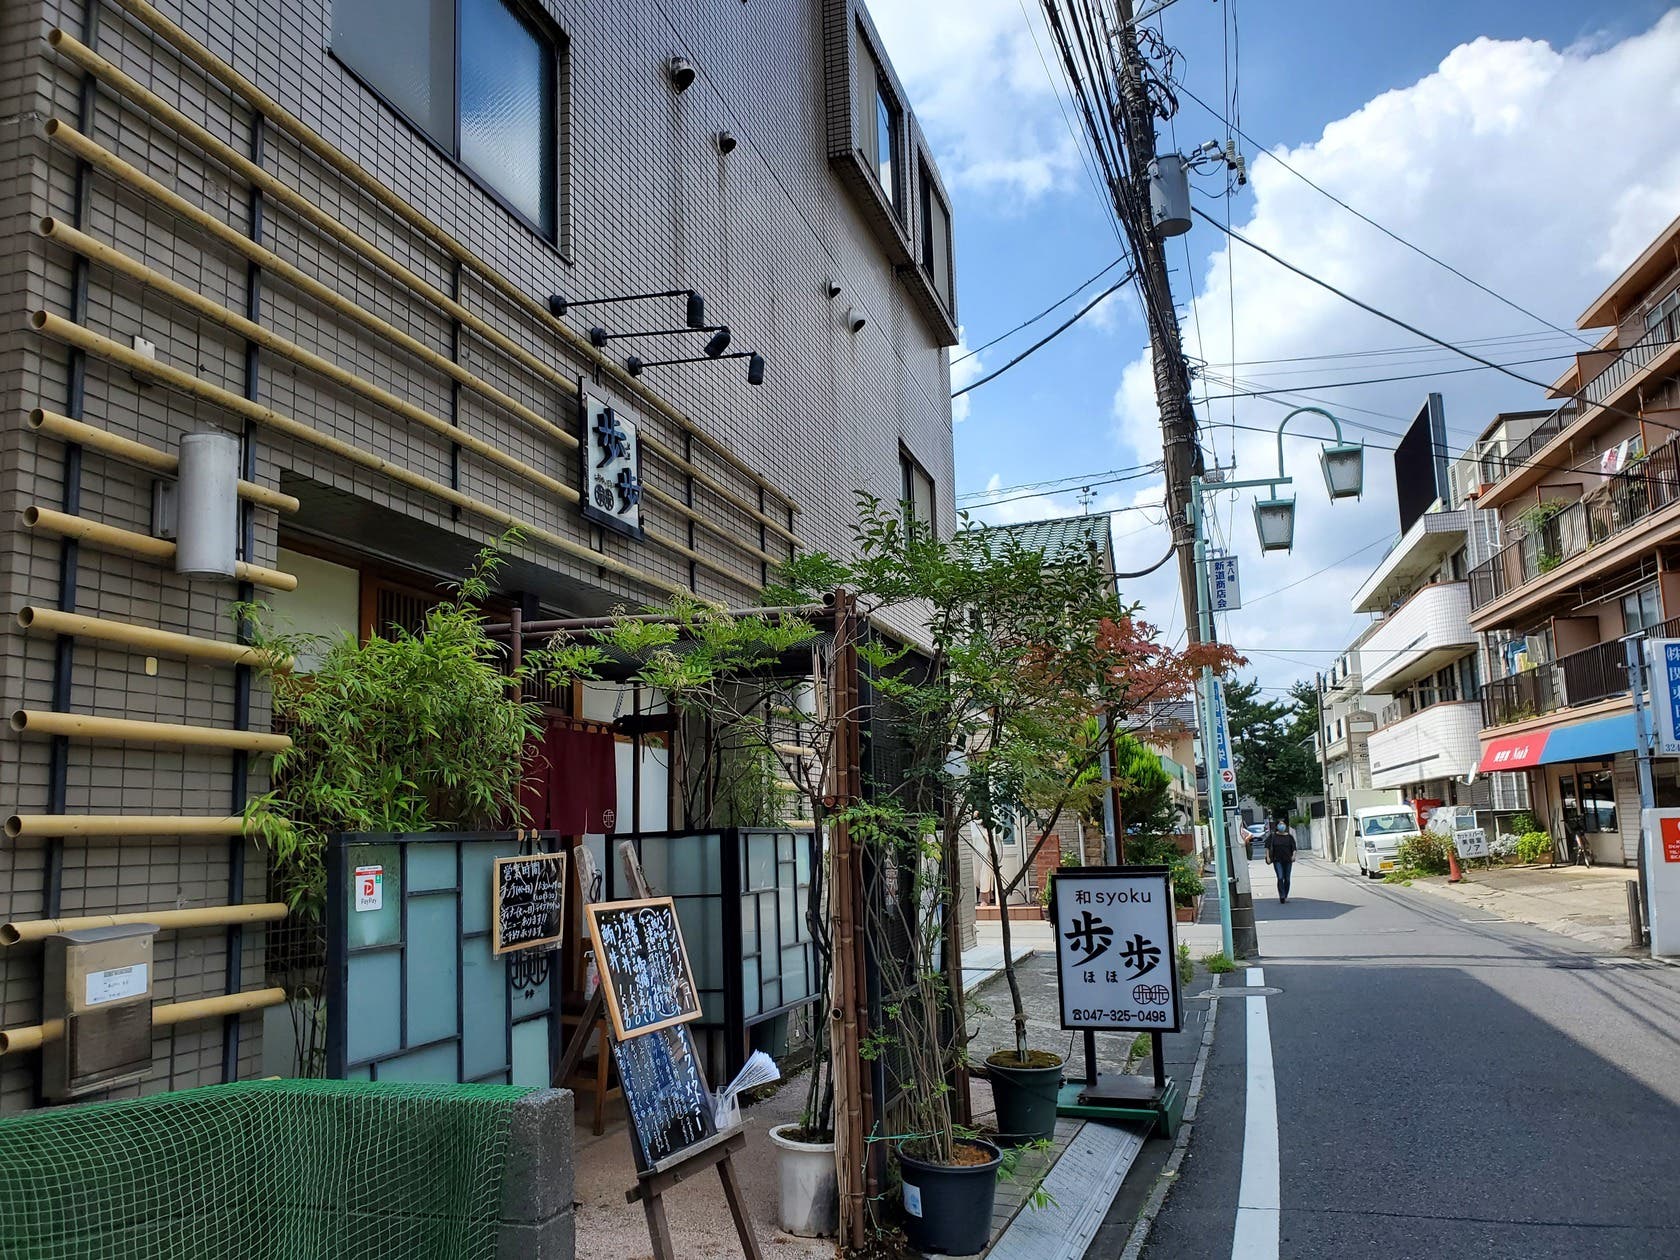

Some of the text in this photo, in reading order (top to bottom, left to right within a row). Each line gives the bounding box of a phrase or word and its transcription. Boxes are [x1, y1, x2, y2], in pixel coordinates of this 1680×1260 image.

[1215, 561, 1227, 608] 新道商店会
[663, 908, 692, 1009] ランチメニュー
[1083, 1010, 1167, 1022] 047-325-0498
[677, 1024, 702, 1104] テイクアウト
